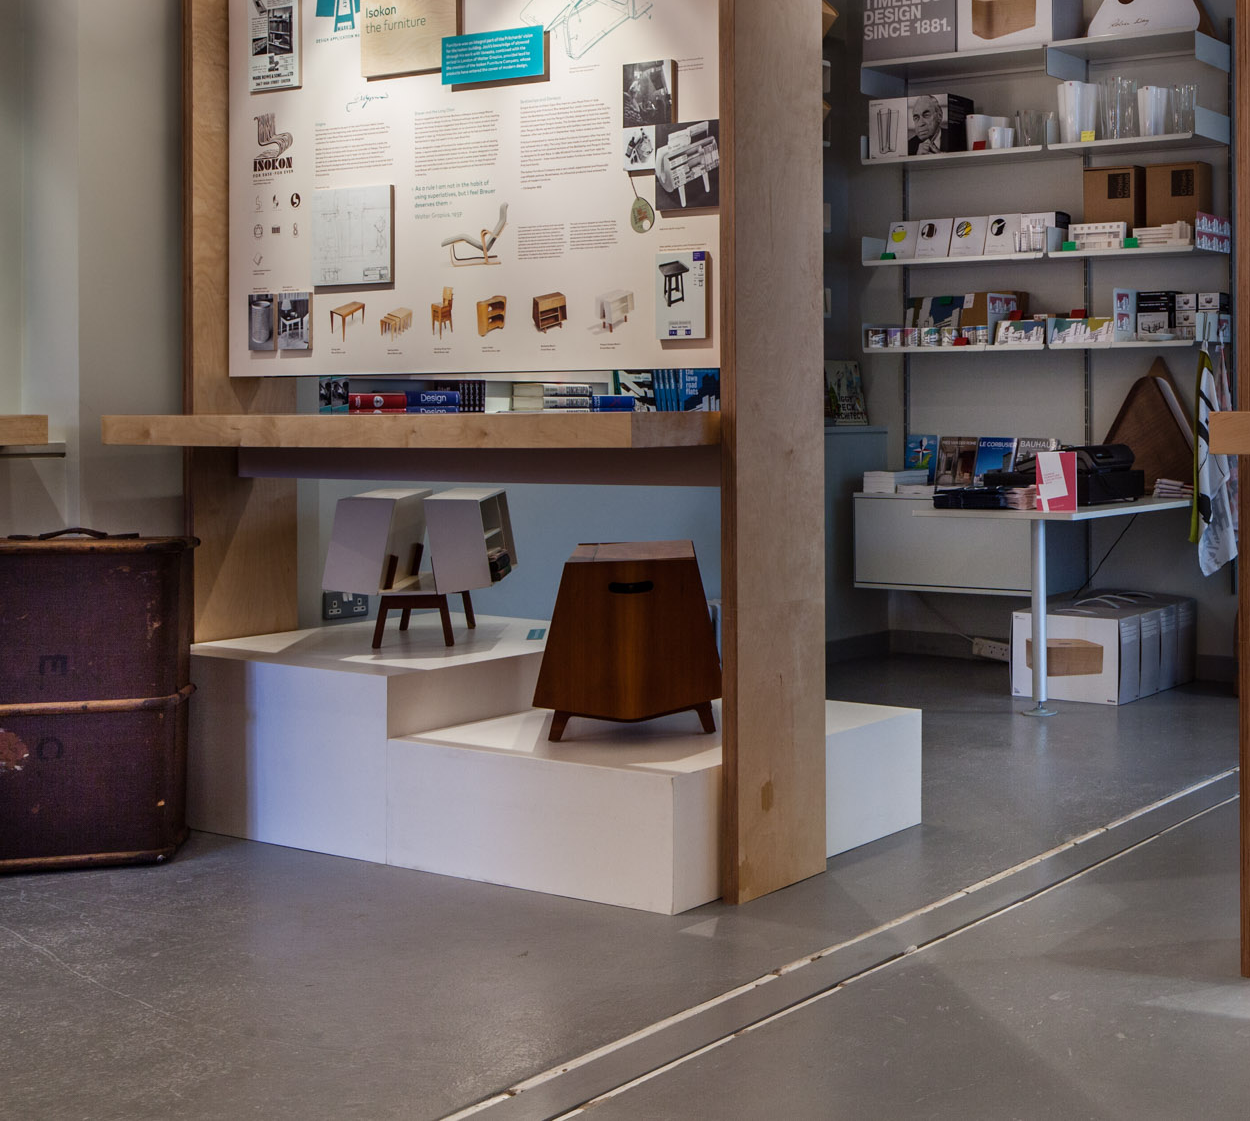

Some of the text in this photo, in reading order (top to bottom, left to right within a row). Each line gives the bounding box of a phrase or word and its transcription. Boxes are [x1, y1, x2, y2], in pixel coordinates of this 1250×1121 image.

[366, 6, 396, 18] Isokon
[864, 5, 921, 25] DESIGN
[366, 18, 426, 34] the furniture
[864, 18, 951, 40] SINCE 1881.
[253, 157, 292, 172] ISOKON
[421, 394, 446, 404] Design
